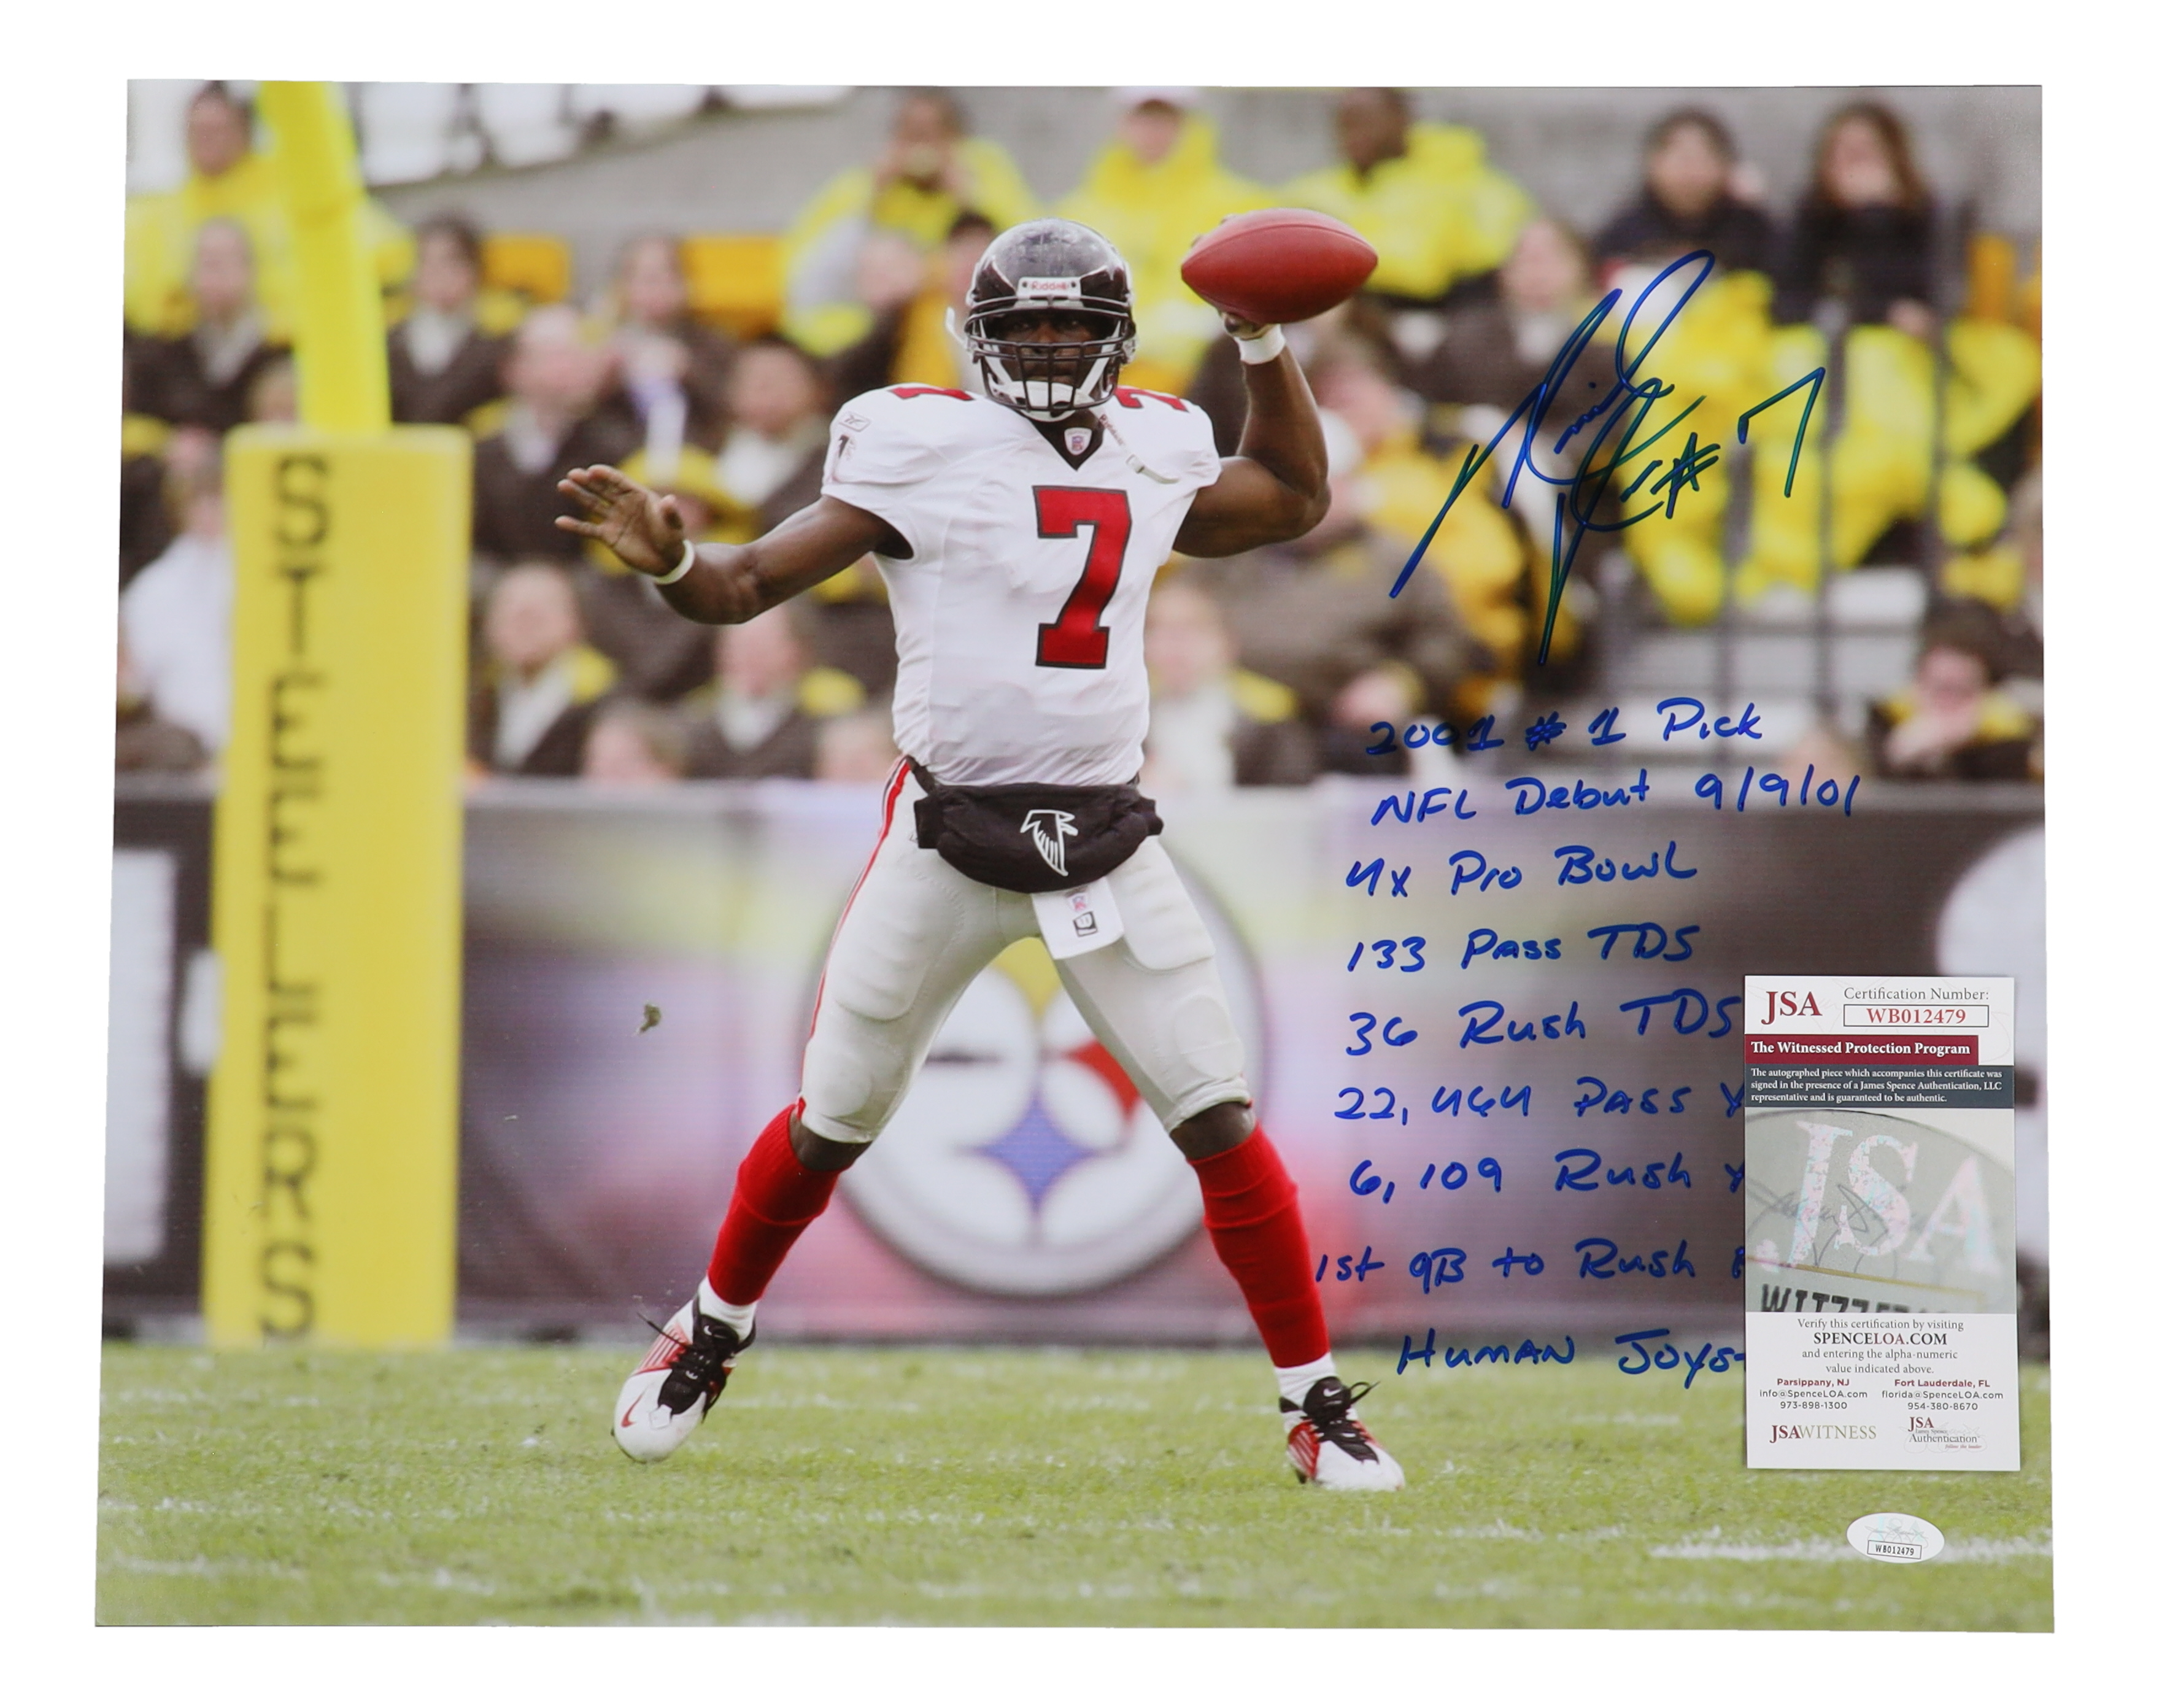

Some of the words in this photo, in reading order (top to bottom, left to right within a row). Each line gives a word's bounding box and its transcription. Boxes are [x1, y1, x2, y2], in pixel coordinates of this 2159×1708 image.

[1032, 485, 1132, 670] 7
[1365, 717, 1504, 755] 2001
[1656, 696, 1763, 741] Pick
[1370, 787, 1477, 826] NFL
[1504, 768, 1650, 816] Debut
[1448, 849, 1523, 896] Pro
[261, 451, 332, 1340] STEELERS
[1346, 935, 1427, 972] 133
[1844, 987, 1926, 1000] Certification
[1930, 987, 1990, 1000] Number:
[1761, 991, 1823, 1026] JSA
[1866, 1008, 1966, 1024] WB012479
[1345, 1011, 1418, 1057] 36
[1458, 999, 1586, 1048] Rush
[1750, 1041, 1775, 1054] The
[1777, 1041, 1842, 1054] Witnessed
[1845, 1042, 1912, 1054] Protection
[1914, 1043, 1971, 1057] Program
[1750, 1068, 1767, 1078] The
[1768, 1068, 1820, 1080] autographed
[1821, 1069, 1843, 1080] piece
[1844, 1068, 1871, 1078] which
[1872, 1070, 1925, 1080] accompanies
[1926, 1069, 1942, 1078] this
[1944, 1069, 1985, 1078] certificate
[1750, 1081, 1778, 1092] signed
[1780, 1081, 1789, 1089] in
[1790, 1080, 1804, 1089] the
[1805, 1082, 1842, 1092] presence
[1843, 1081, 1853, 1089] of
[1859, 1081, 1885, 1091] James
[1886, 1081, 1916, 1092] Spence
[1917, 1081, 1982, 1092] Authentication,
[1983, 1081, 2003, 1091] LLC
[1750, 1093, 1809, 1103] representative
[1810, 1092, 1826, 1102] and
[1828, 1092, 1835, 1102] is
[1836, 1093, 1882, 1104] guaranteed
[1894, 1093, 1905, 1102] be
[1906, 1093, 1948, 1102] authentic.
[1553, 1147, 1691, 1193] Rush
[1315, 1245, 1385, 1283] 1st
[1491, 1246, 1545, 1278] to
[1574, 1237, 1696, 1280] Rush
[1797, 1318, 1828, 1331] Verify
[1830, 1319, 1848, 1329] this
[1851, 1319, 1910, 1329] certification
[1913, 1320, 1925, 1332] by
[1927, 1320, 1964, 1332] visiting
[1813, 1332, 1947, 1346] SPENCELOA.COM
[1802, 1349, 1821, 1359] and
[1823, 1349, 1864, 1361] entering
[1866, 1349, 1883, 1359] the
[1885, 1350, 1958, 1361] alpha-numeric
[1826, 1364, 1852, 1374] value
[1854, 1364, 1900, 1374] indicated
[1902, 1364, 1934, 1374] above.
[1777, 1378, 1834, 1388] Parsippany,
[1918, 1379, 1976, 1388] Lauderdale,
[1759, 1389, 1868, 1399] info@SpenceLOA.com
[1882, 1391, 2004, 1400] florida@SpenceLOA.com
[1780, 1401, 1848, 1410] 973-898-1300
[1907, 1402, 1979, 1411] 954-380-8670
[1907, 1416, 1934, 1432] JSA
[1769, 1424, 1877, 1443] JSAWITNESS
[1875, 1544, 1915, 1556] WB012479
